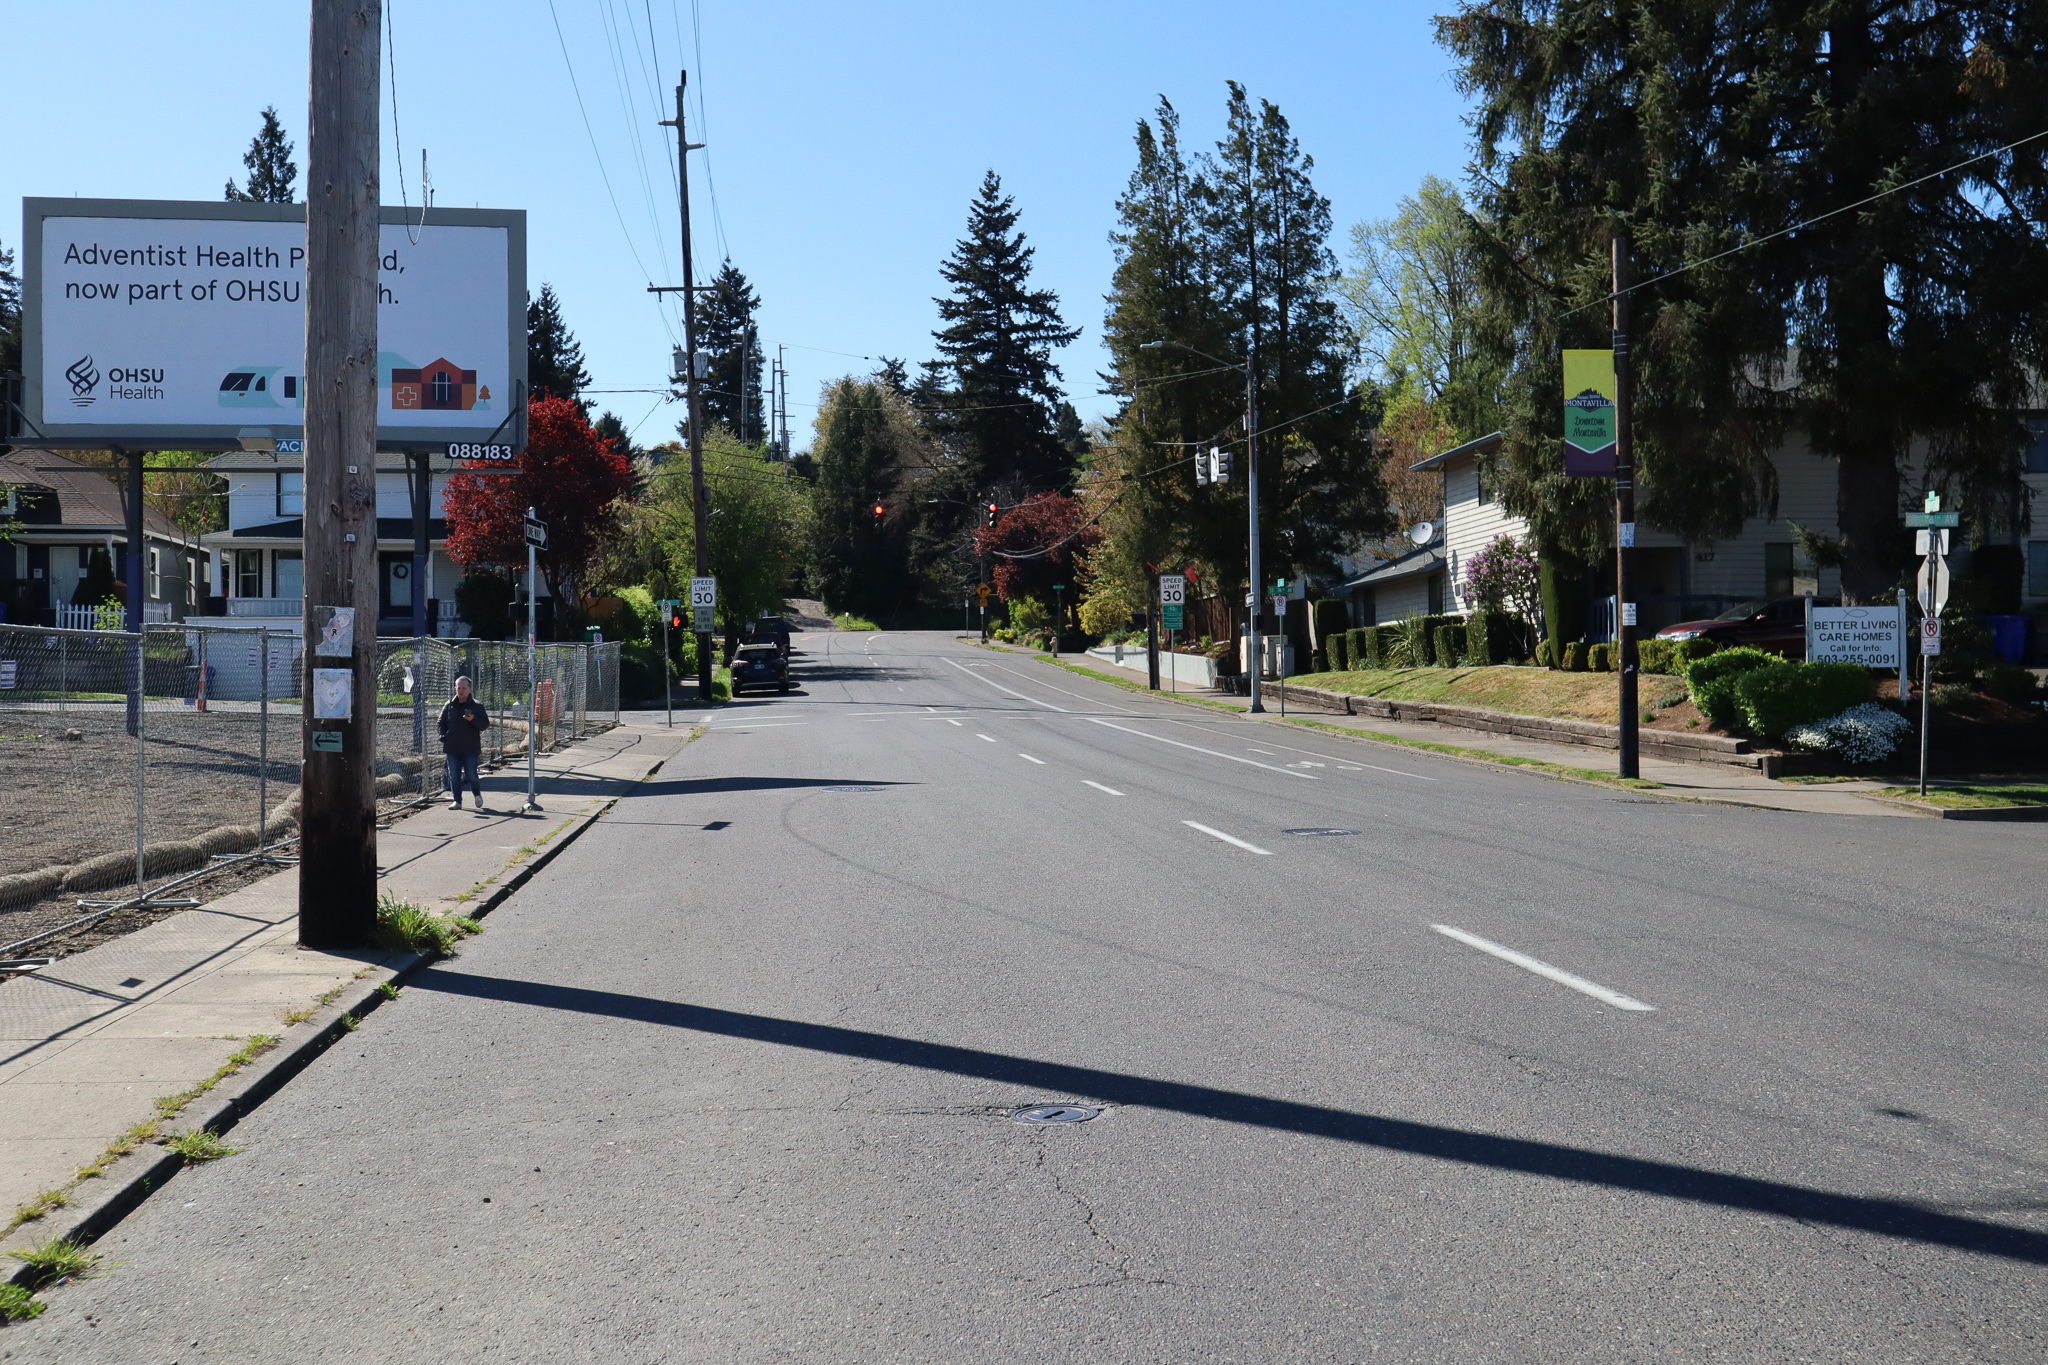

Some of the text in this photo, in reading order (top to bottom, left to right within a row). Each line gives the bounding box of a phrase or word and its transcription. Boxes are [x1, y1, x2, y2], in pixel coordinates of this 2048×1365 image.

[64, 242, 187, 266] Adventist
[196, 245, 279, 268] Health
[65, 278, 300, 305] now part of OHSU
[108, 367, 164, 383] OHSU
[110, 384, 164, 399] Health
[1575, 416, 1605, 426] Downtown
[1573, 428, 1607, 437] Montavilla
[448, 443, 512, 460] 088183
[1944, 514, 1956, 524] AV
[694, 593, 713, 604] 30
[1163, 591, 1182, 601] 30
[1814, 620, 1897, 630] BETTER LIVING
[1819, 632, 1892, 642] CARE HOMES
[1817, 654, 1896, 664] 503-255-0091
